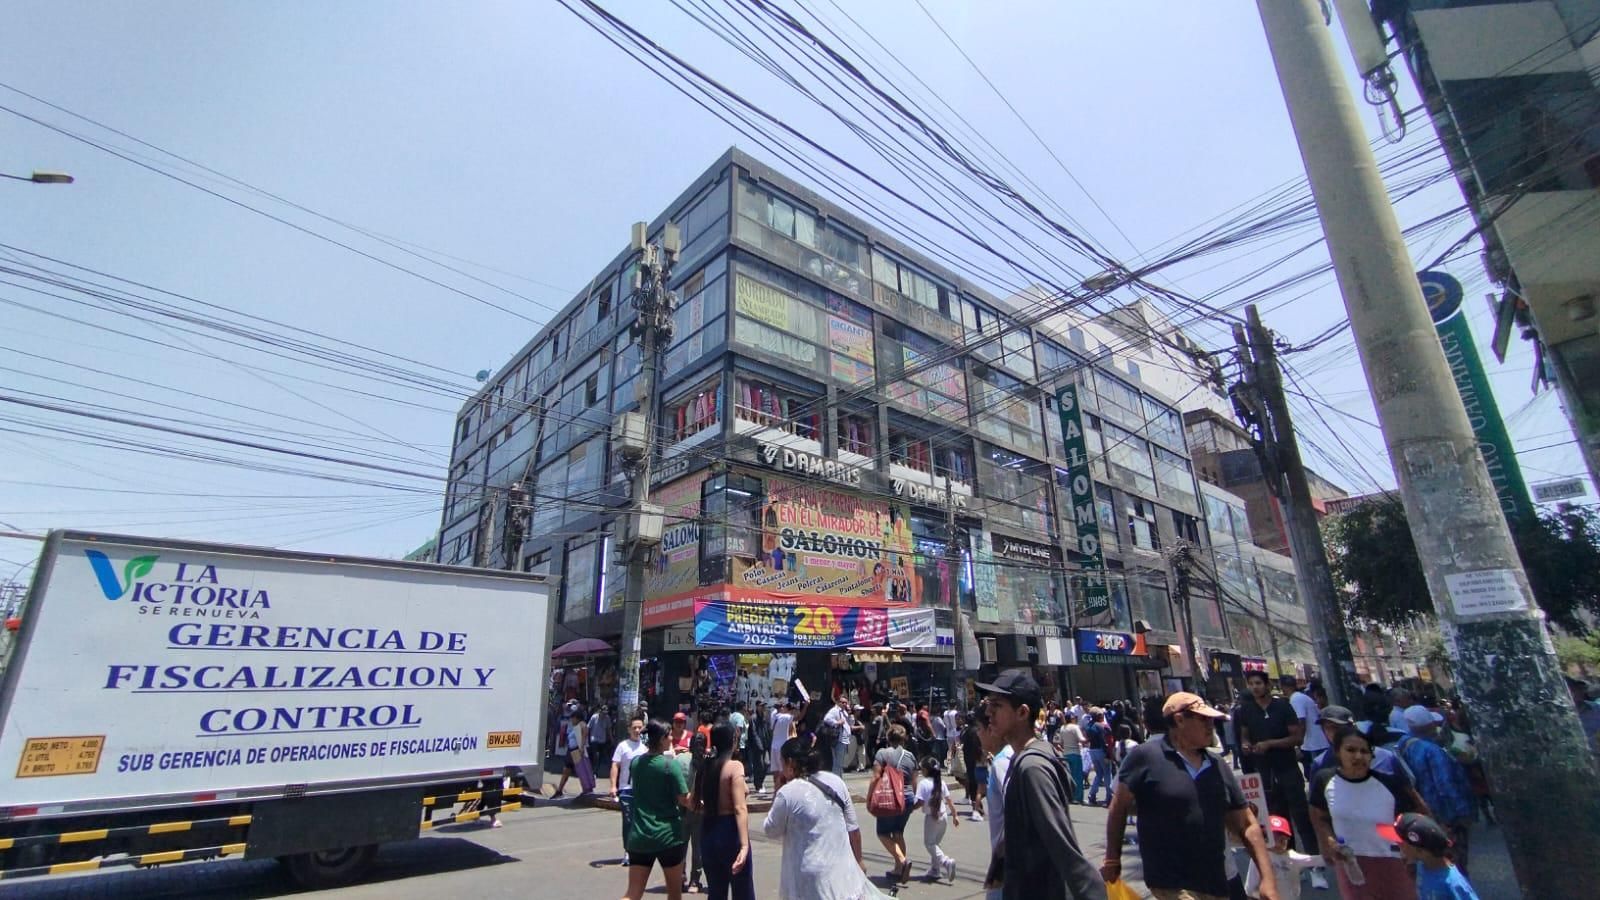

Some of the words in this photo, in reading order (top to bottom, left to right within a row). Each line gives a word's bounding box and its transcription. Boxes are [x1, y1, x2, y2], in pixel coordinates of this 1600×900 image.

[783, 449, 861, 483] DAMARIS
[780, 503, 797, 523] EN
[801, 508, 814, 527] EL
[816, 513, 866, 534] MIRADOR
[869, 521, 883, 538] DE
[781, 528, 881, 560] SALOMON
[174, 562, 219, 584] LA
[743, 568, 766, 581] Polos
[756, 571, 786, 586] Casacas
[777, 577, 798, 590] Jeans
[798, 576, 824, 591] Poleras
[139, 605, 162, 615] SE
[168, 607, 261, 619] RENUEVA
[726, 604, 789, 616] IMPUESTO
[726, 613, 776, 625] PREDIAL
[780, 615, 788, 625] Y
[727, 623, 790, 635] ARBITRIOS
[168, 623, 407, 650] GERENCIA
[418, 631, 468, 651] DE
[743, 634, 777, 645] 2025
[102, 665, 462, 689] FISCALIZACION
[473, 668, 497, 687] Y
[199, 704, 422, 733] CONTROL
[117, 754, 155, 773] SUB
[159, 749, 241, 770] GERENCIA
[246, 748, 268, 765] DE
[270, 743, 367, 763] OPERACIONES
[372, 742, 386, 757] DE
